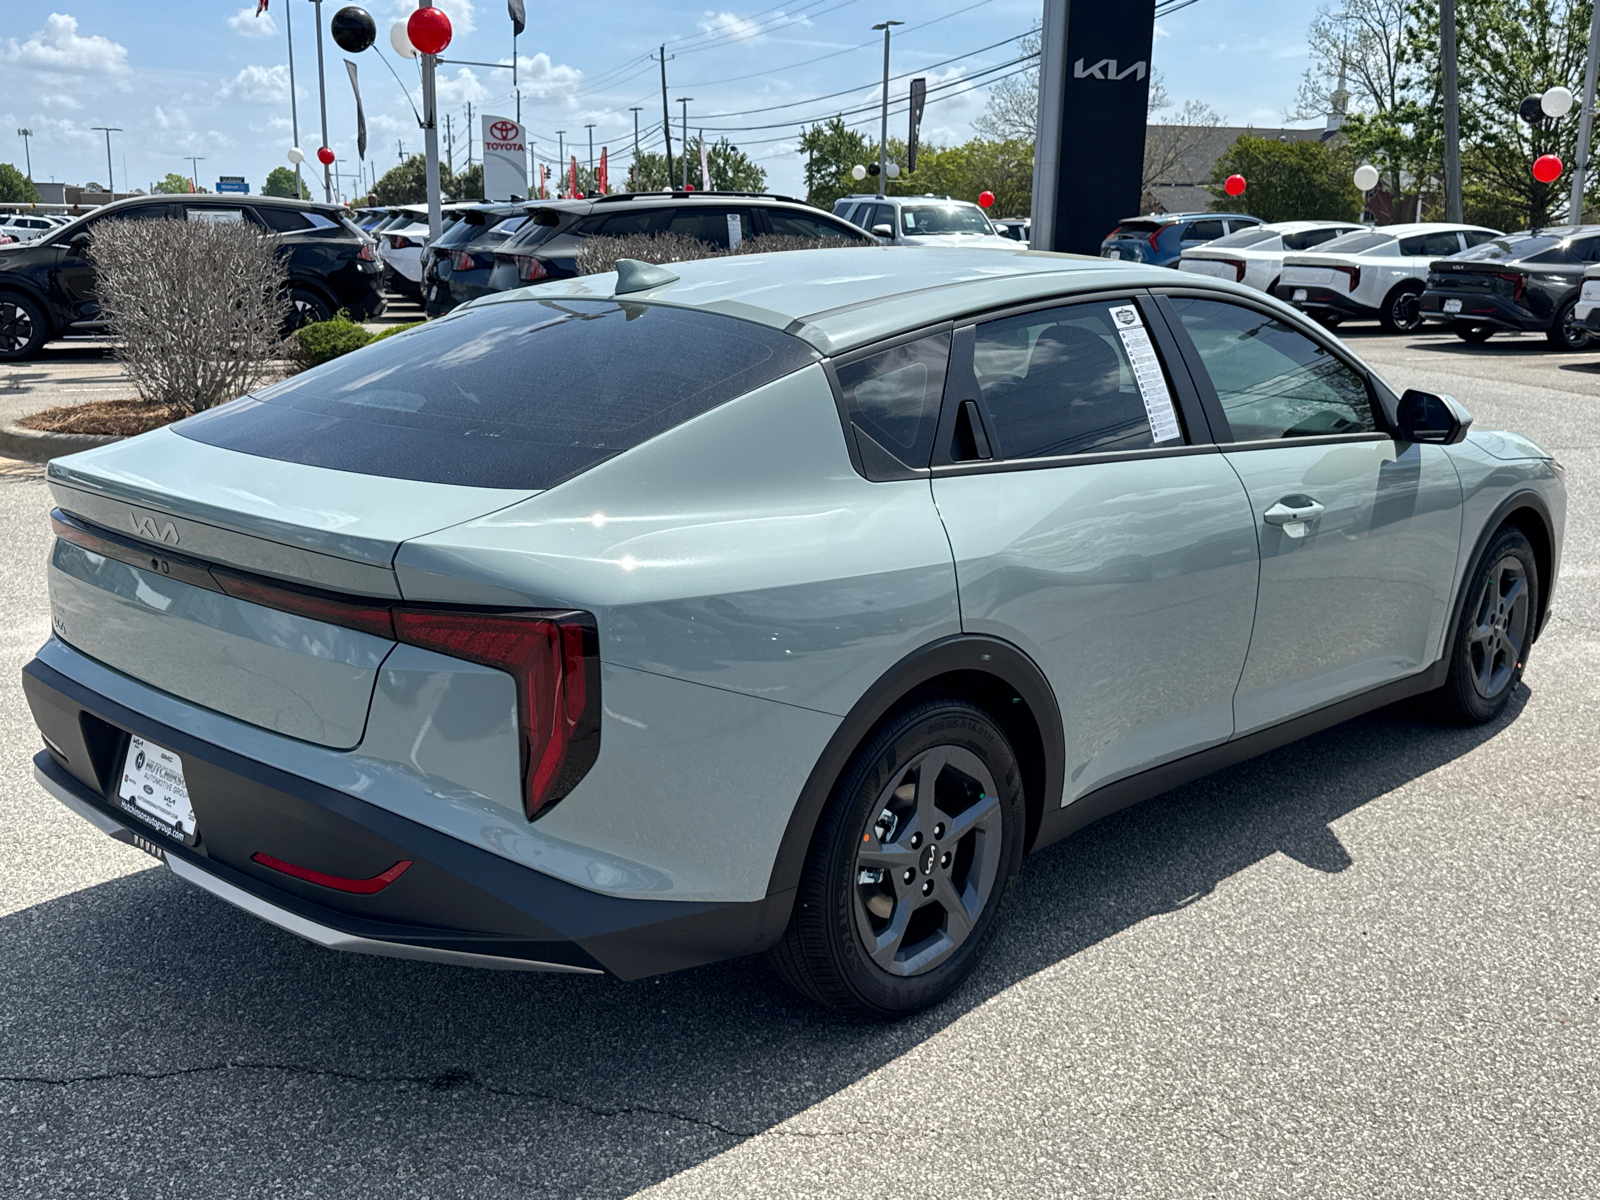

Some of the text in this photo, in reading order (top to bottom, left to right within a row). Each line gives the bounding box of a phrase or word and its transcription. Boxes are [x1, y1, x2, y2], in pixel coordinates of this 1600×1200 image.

[1074, 57, 1146, 81] KIA
[485, 142, 524, 151] TOYOTA
[129, 511, 180, 545] KIA
[133, 737, 144, 747] KIA
[143, 772, 172, 791] AUTOMOTIVE
[164, 795, 176, 805] KIA
